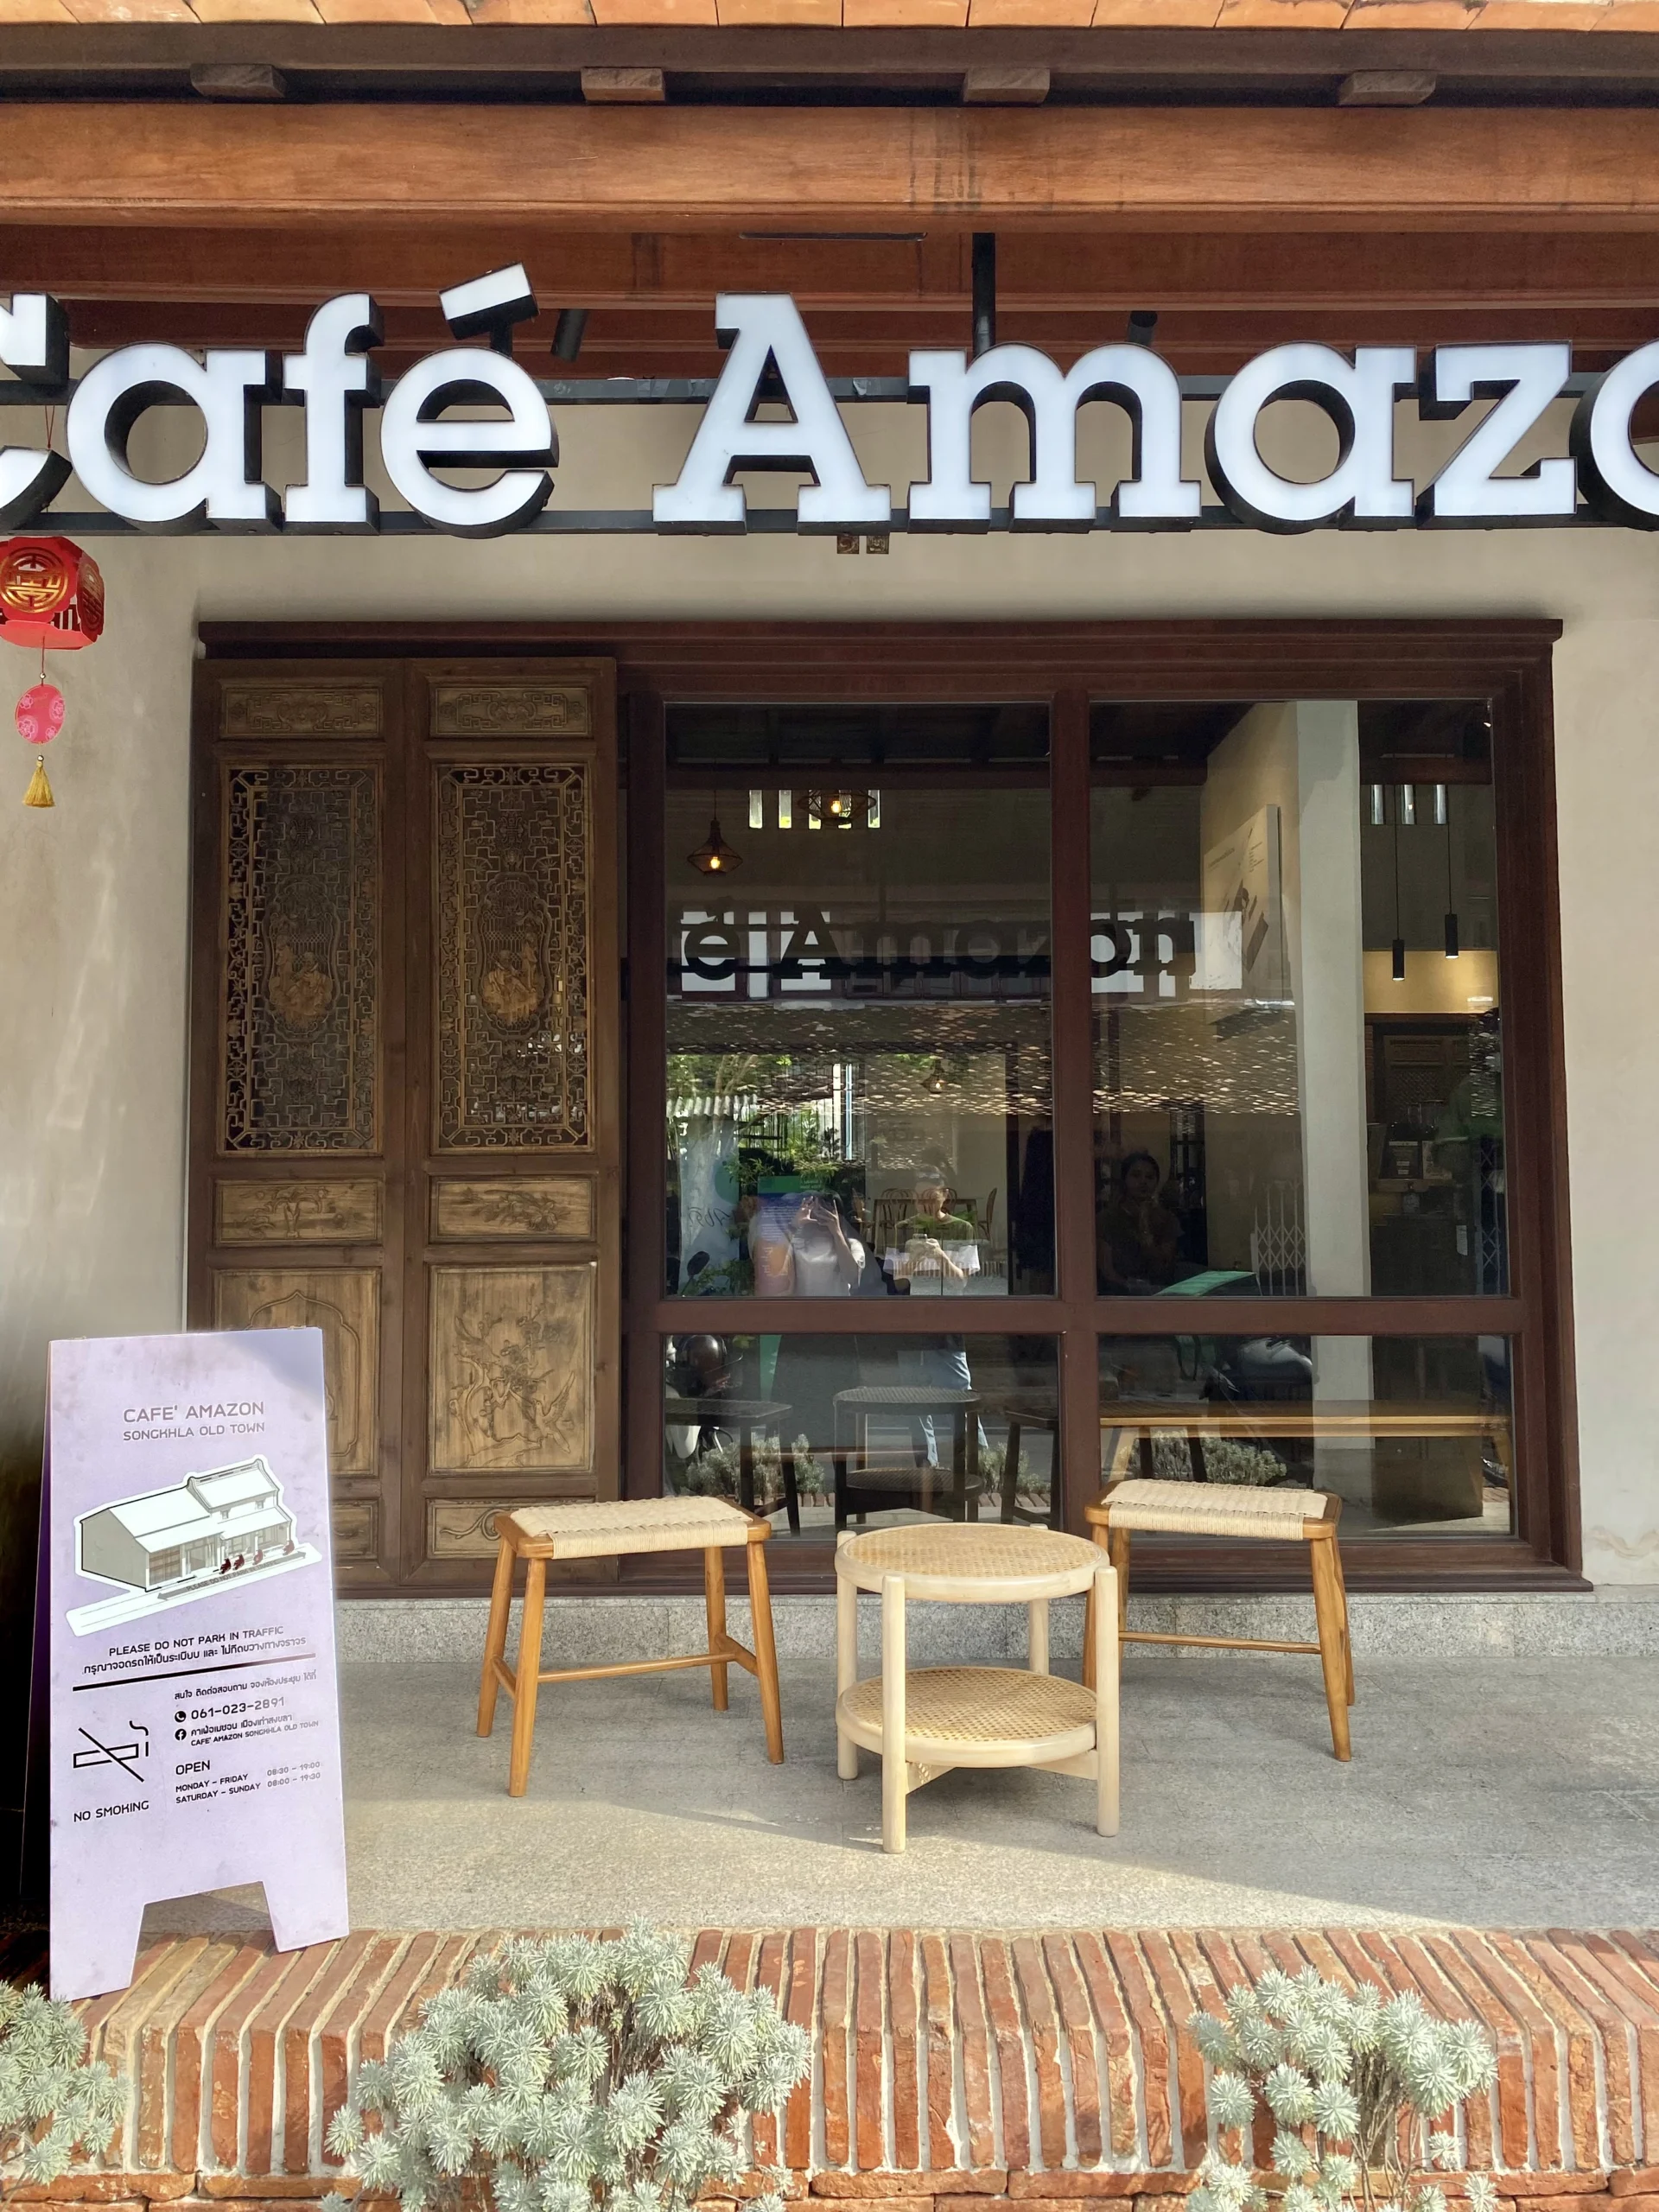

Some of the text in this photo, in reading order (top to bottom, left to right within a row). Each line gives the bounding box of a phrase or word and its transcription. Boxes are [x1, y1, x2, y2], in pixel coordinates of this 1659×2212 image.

[186, 1402, 264, 1419] AMAZON
[124, 1422, 264, 1441] SONGKHLA OLD TOWN
[186, 1581, 208, 1591] PLEASE
[109, 1626, 283, 1656] PLEASE DO NOT PARK IN TRAFFIC
[204, 1649, 218, 1658] และ
[175, 1689, 192, 1700] สนใจ
[196, 1682, 247, 1697] ติดต่อสอบถาม
[191, 1697, 284, 1719] 061-023-2891
[213, 1733, 243, 1743] AMAZON
[245, 1726, 282, 1737] SONGKHLA
[176, 1760, 210, 1775] OPEN
[176, 1781, 209, 1792] MONDAY
[220, 1774, 248, 1784] FRIDAY
[267, 1767, 289, 1776] 08:30
[300, 1762, 321, 1770] 19:00
[176, 1790, 218, 1803] SATURDAY
[229, 1783, 261, 1794] SUNDAY
[268, 1778, 289, 1787] 08:00
[301, 1772, 321, 1782] 19:30
[73, 1801, 149, 1822] NO SMOKING
